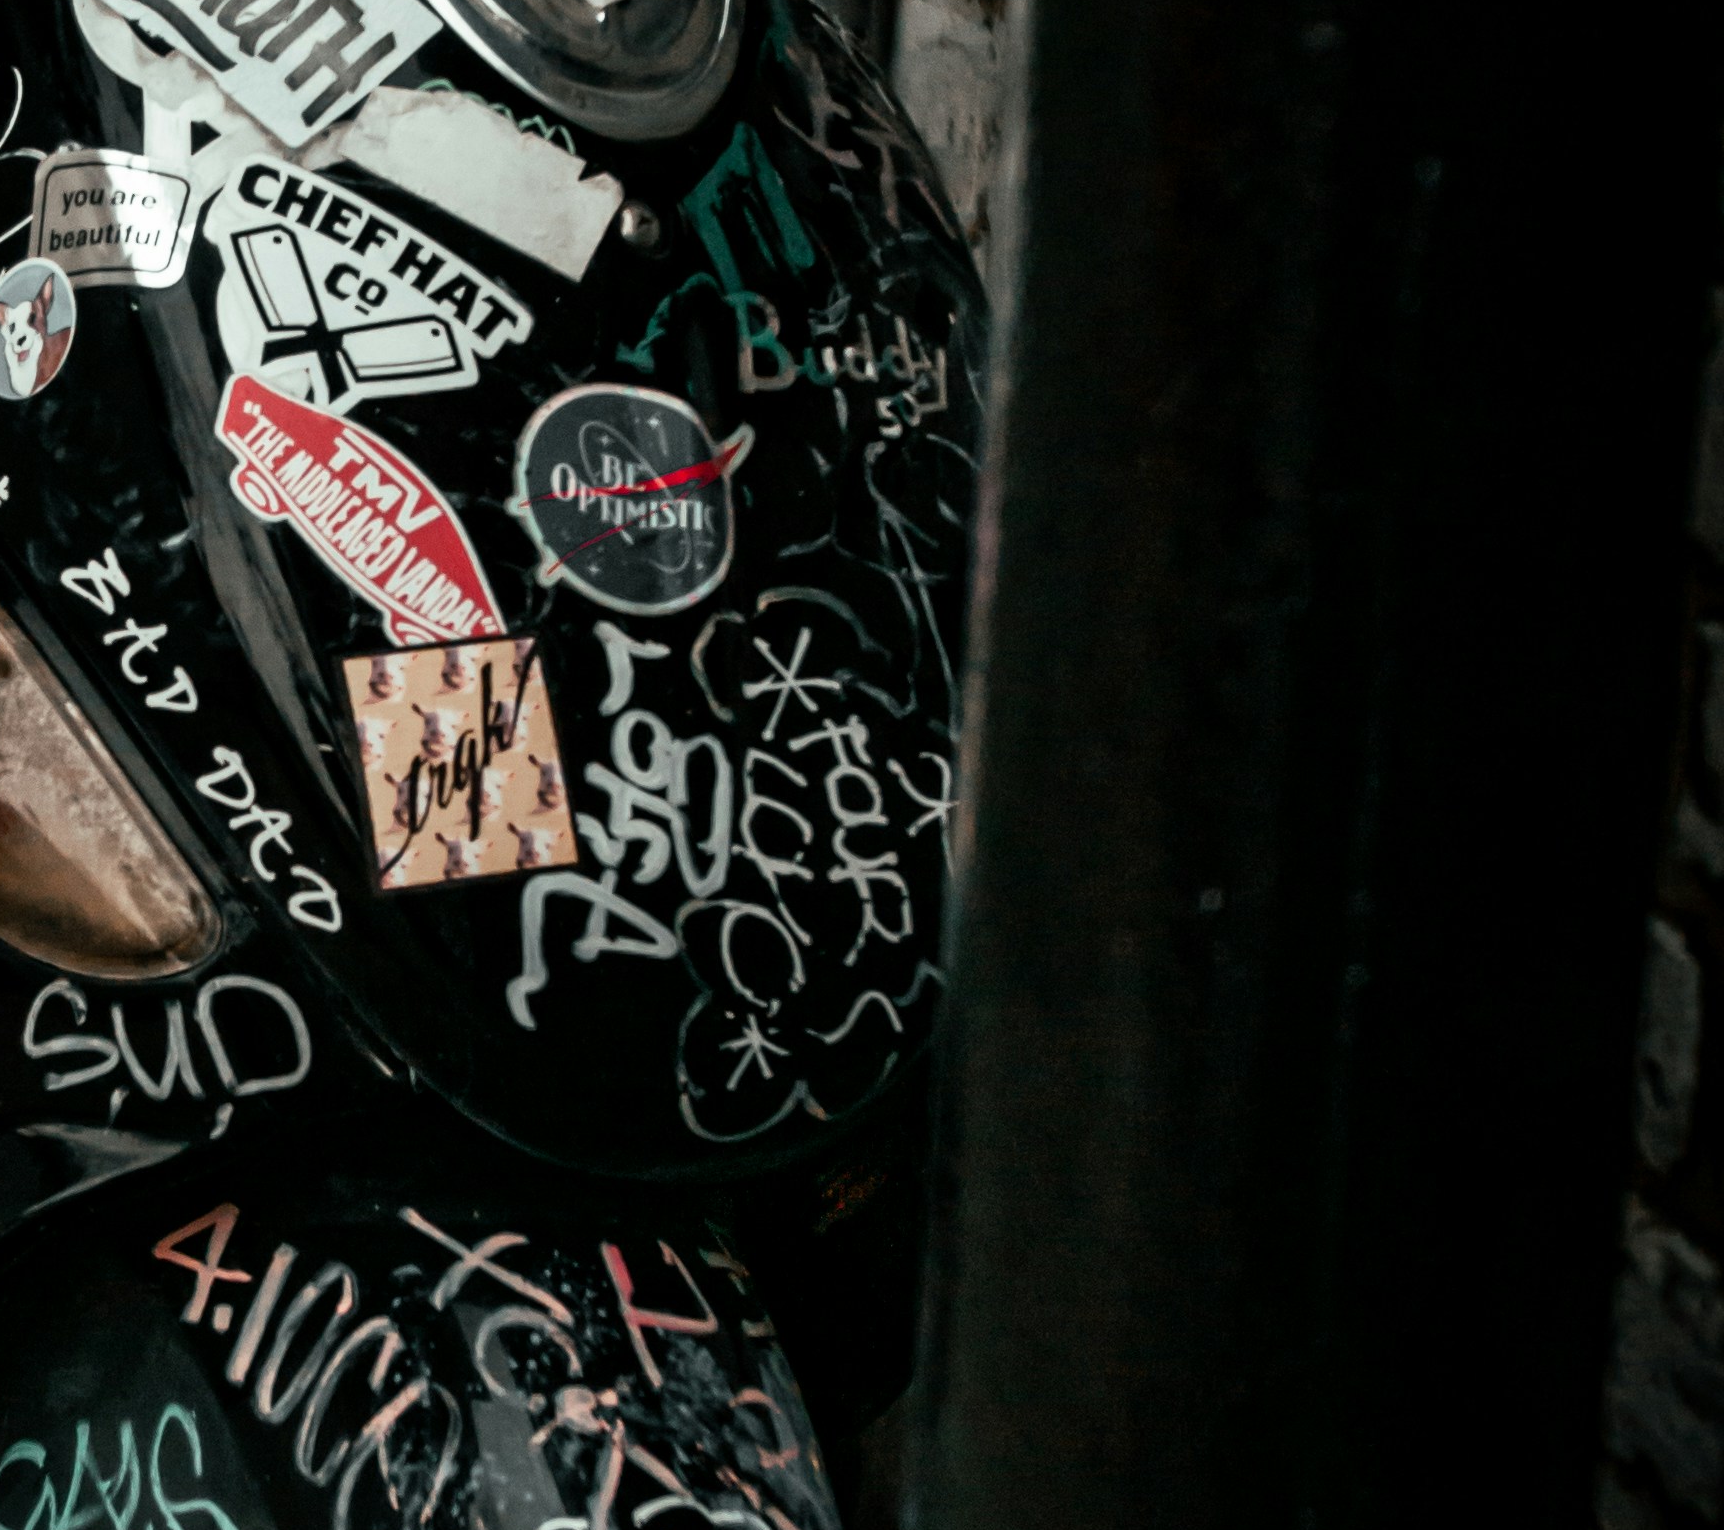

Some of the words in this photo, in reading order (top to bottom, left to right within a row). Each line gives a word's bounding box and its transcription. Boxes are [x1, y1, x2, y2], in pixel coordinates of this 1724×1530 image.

[62, 188, 105, 215] you
[110, 189, 159, 212] are
[49, 223, 162, 252] beautiful
[237, 164, 399, 257] CHEF
[389, 236, 519, 344] HAT
[324, 262, 389, 313] CO
[327, 429, 444, 534] TMV
